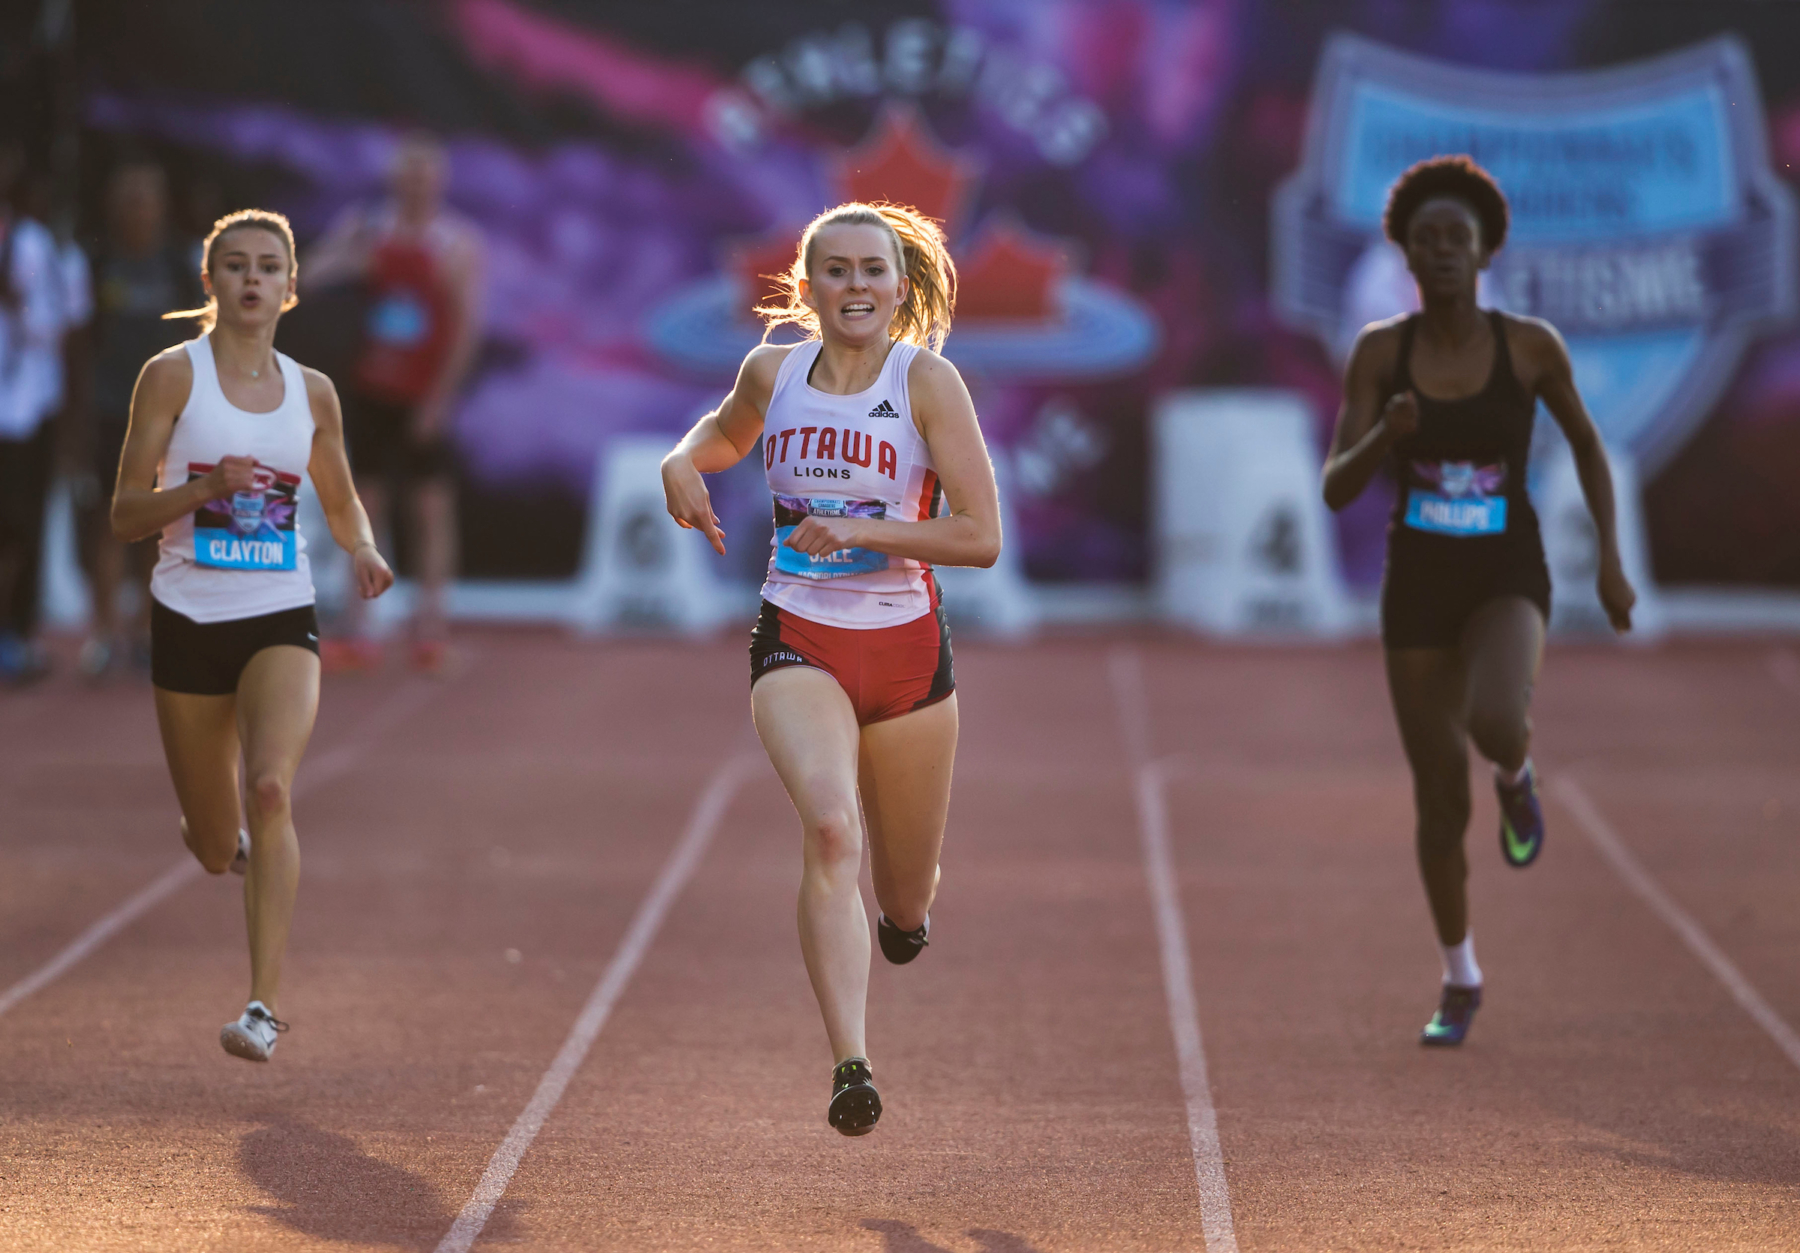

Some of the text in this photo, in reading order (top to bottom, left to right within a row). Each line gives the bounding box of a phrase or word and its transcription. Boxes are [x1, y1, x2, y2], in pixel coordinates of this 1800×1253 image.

[868, 410, 900, 419] adidas
[766, 426, 897, 481] OTTAWA
[794, 466, 851, 480] LIONS
[209, 539, 283, 565] CLAYTON
[763, 651, 803, 668] OTTAWA
